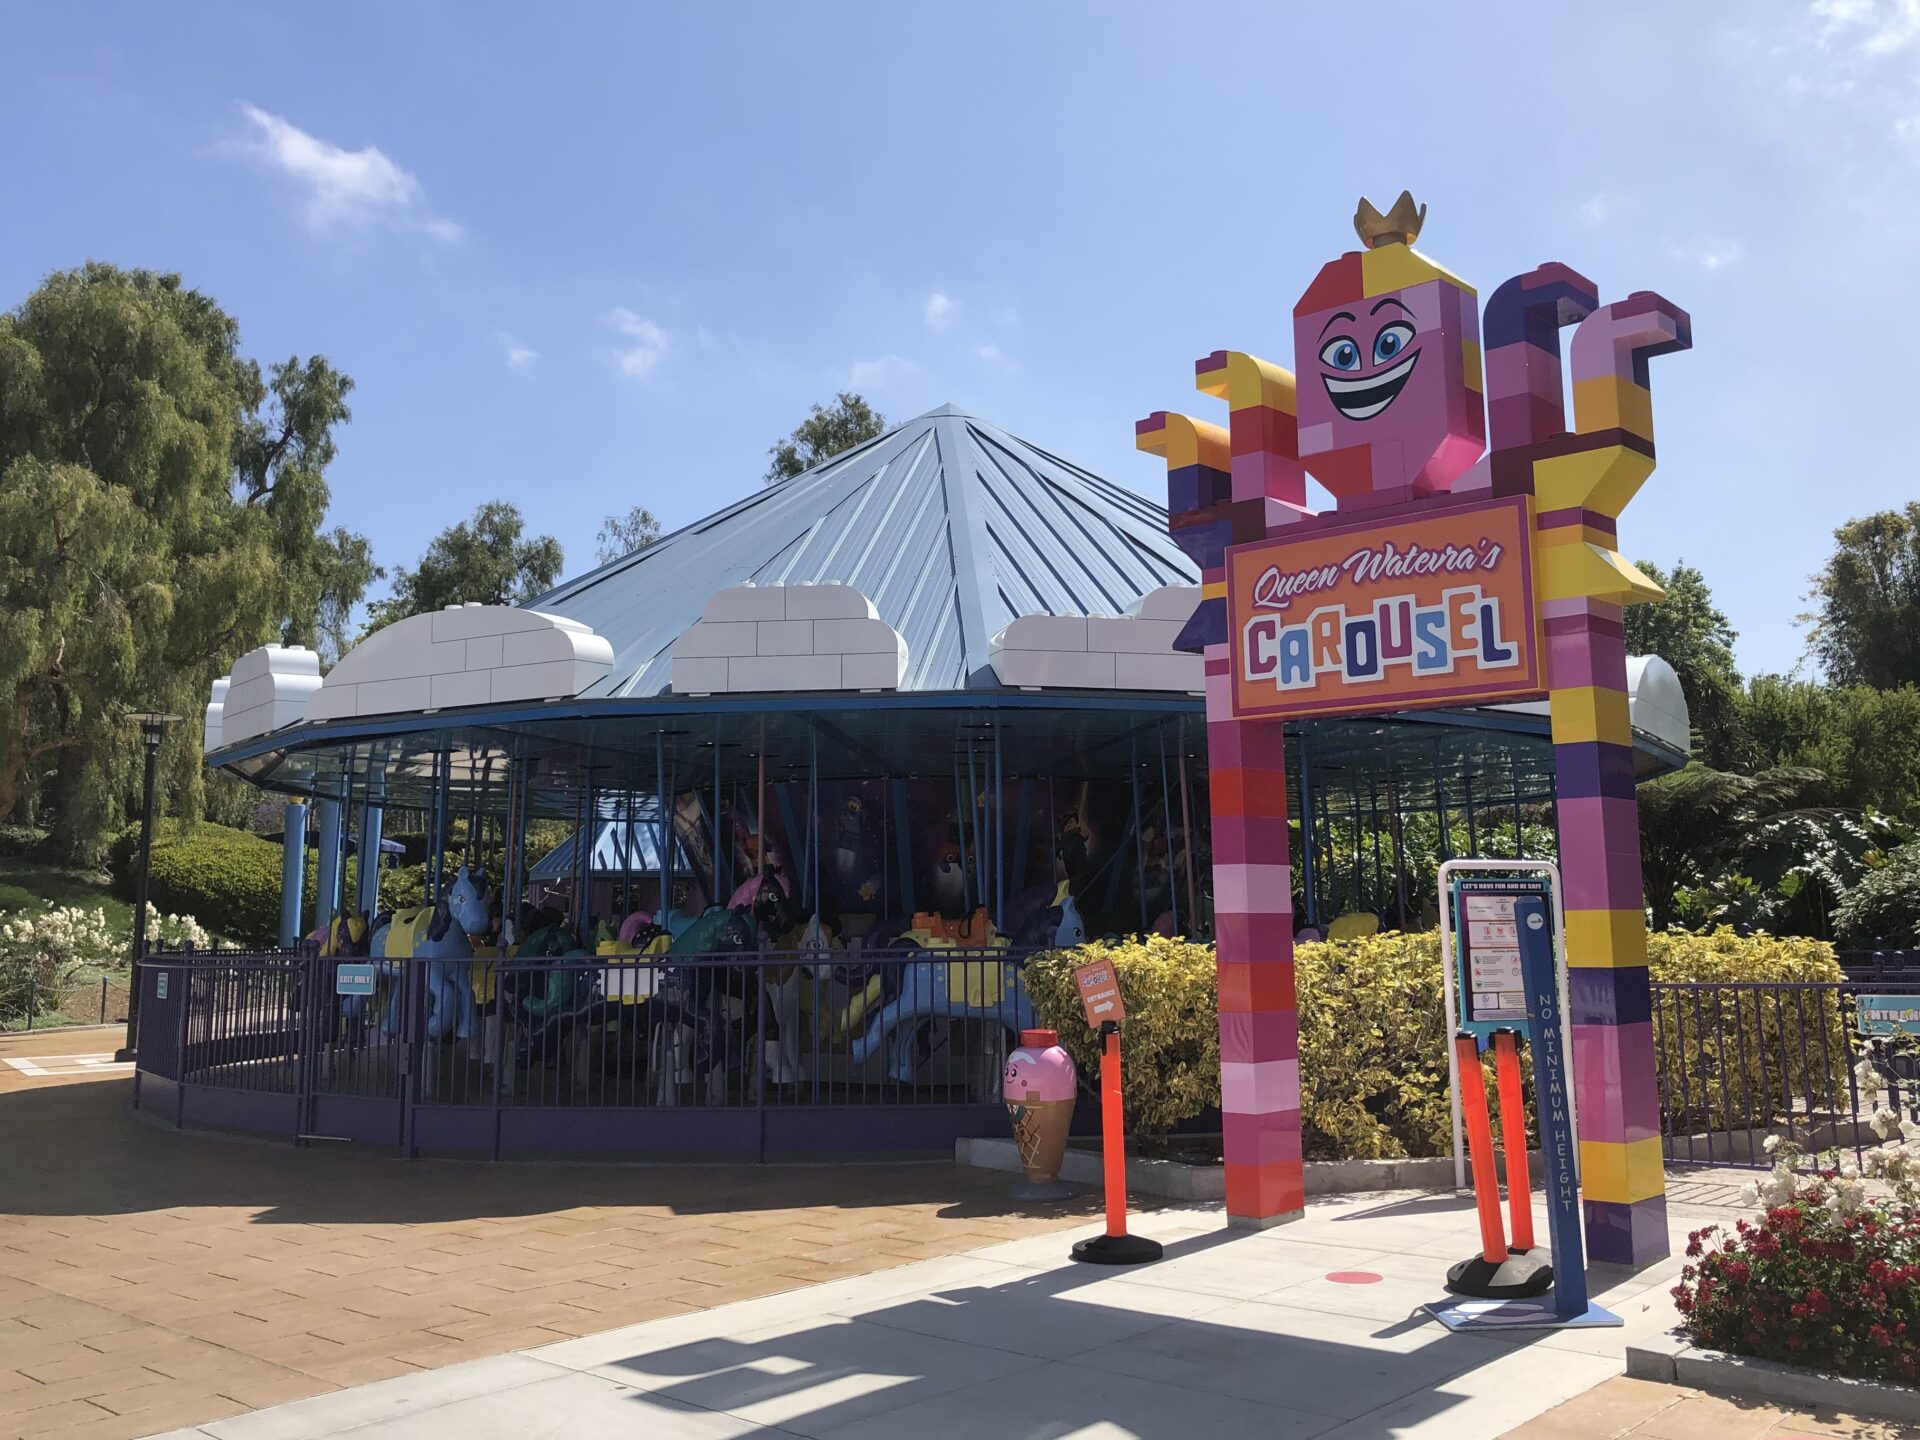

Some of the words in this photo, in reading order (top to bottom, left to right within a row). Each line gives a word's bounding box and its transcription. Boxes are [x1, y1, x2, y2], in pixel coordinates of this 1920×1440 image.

[1253, 567, 1339, 608] Queen
[1343, 541, 1502, 584] Watevra's
[1243, 584, 1519, 691] CAROUSEL
[340, 975, 354, 984] EXIT
[354, 975, 371, 984] ONLY
[1087, 989, 1116, 1003] ENTRANCE
[1540, 994, 1552, 1020] NO
[1864, 1009, 1920, 1021] NTRAN
[1543, 1027, 1565, 1122] MINIMUM
[1555, 1129, 1572, 1212] HEIGHT
